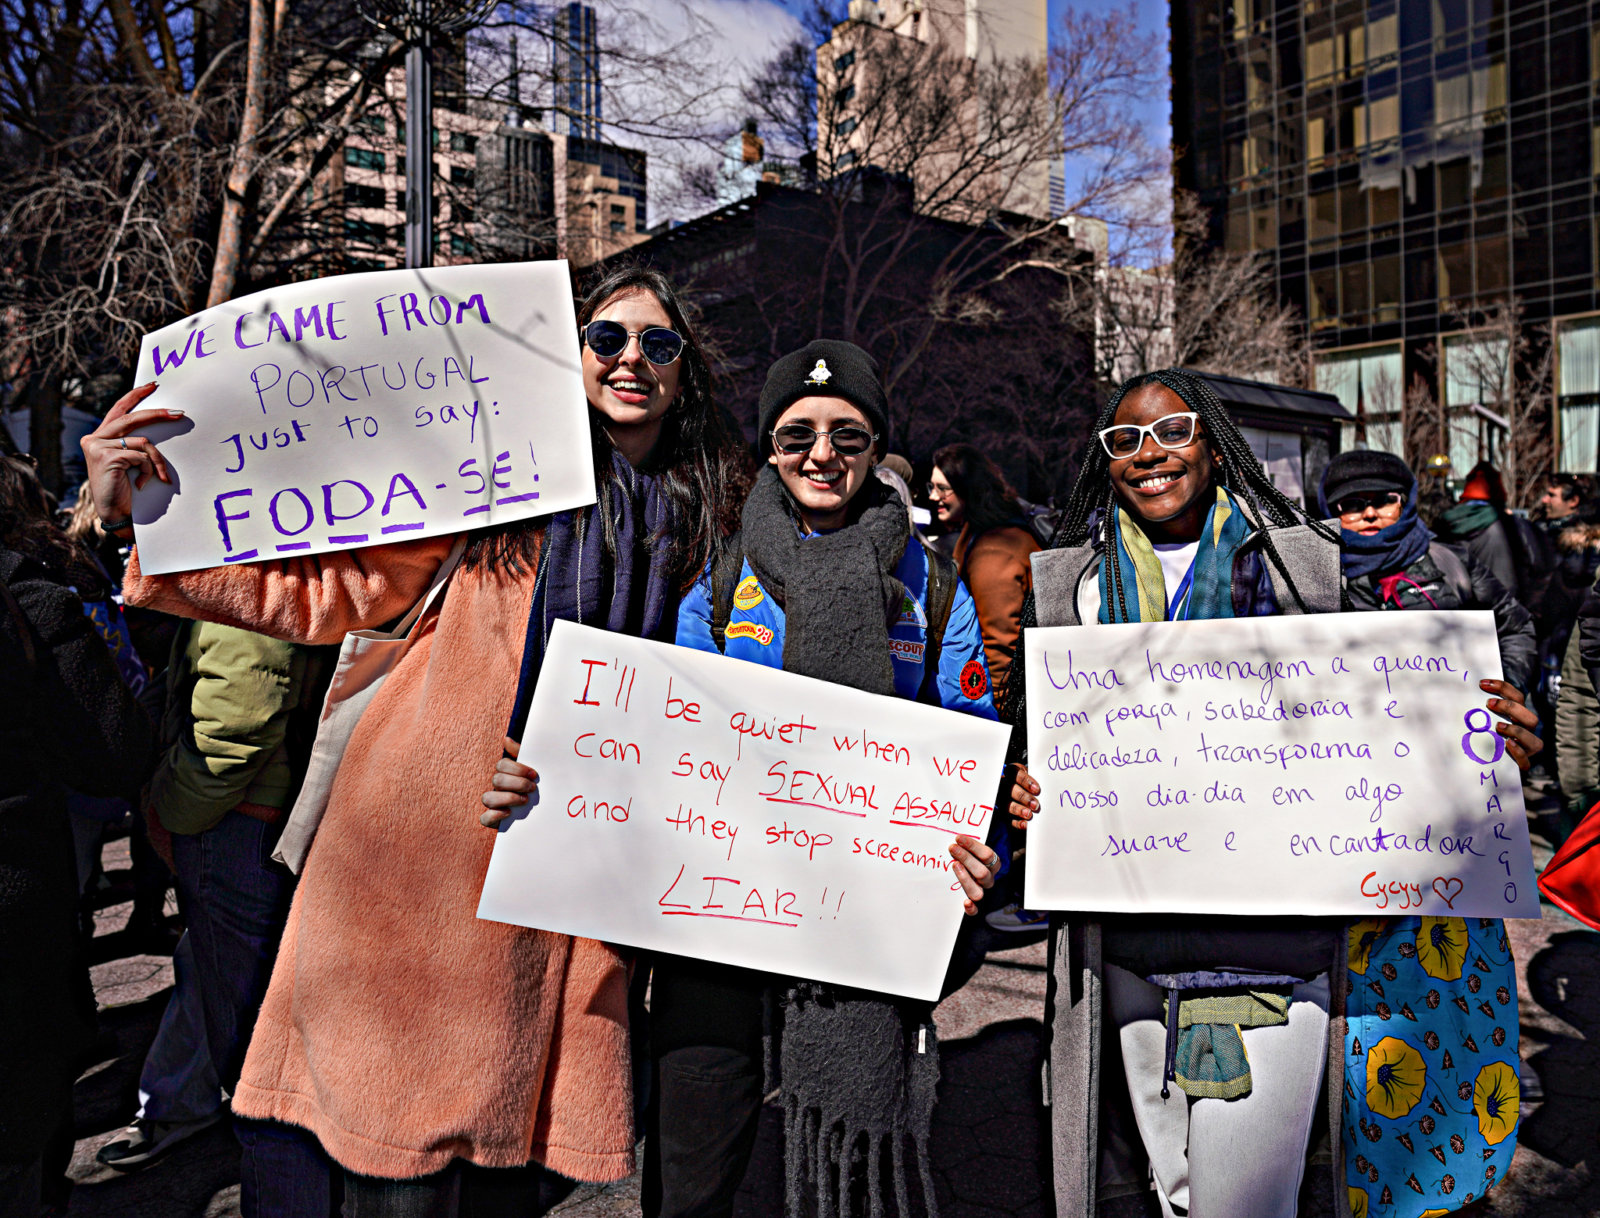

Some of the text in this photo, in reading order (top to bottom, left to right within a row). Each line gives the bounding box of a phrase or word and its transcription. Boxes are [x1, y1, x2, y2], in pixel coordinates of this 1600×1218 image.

[152, 293, 490, 376] WE CAME FROM
[250, 356, 489, 419] PORTUGAL
[339, 416, 378, 439] to
[888, 641, 924, 655] SCOUT
[1045, 650, 1123, 689] Uma
[1146, 649, 1315, 705] homenagem
[1331, 656, 1350, 674] a
[574, 659, 979, 785] I'll be quiet when we
[1043, 710, 1090, 729] com
[1206, 694, 1351, 720] sabedoria
[1384, 699, 1405, 719] e
[1461, 708, 1505, 765] 8
[1196, 730, 1373, 771] transforma
[1394, 741, 1410, 758] o
[574, 733, 994, 828] can say SEXUAL ASSAULT
[1060, 790, 1118, 808] nosso
[1271, 785, 1315, 807] em
[1344, 776, 1405, 824] algo
[567, 795, 964, 892] and they stop screamin
[1100, 831, 1192, 857] suave
[1224, 831, 1237, 851] e
